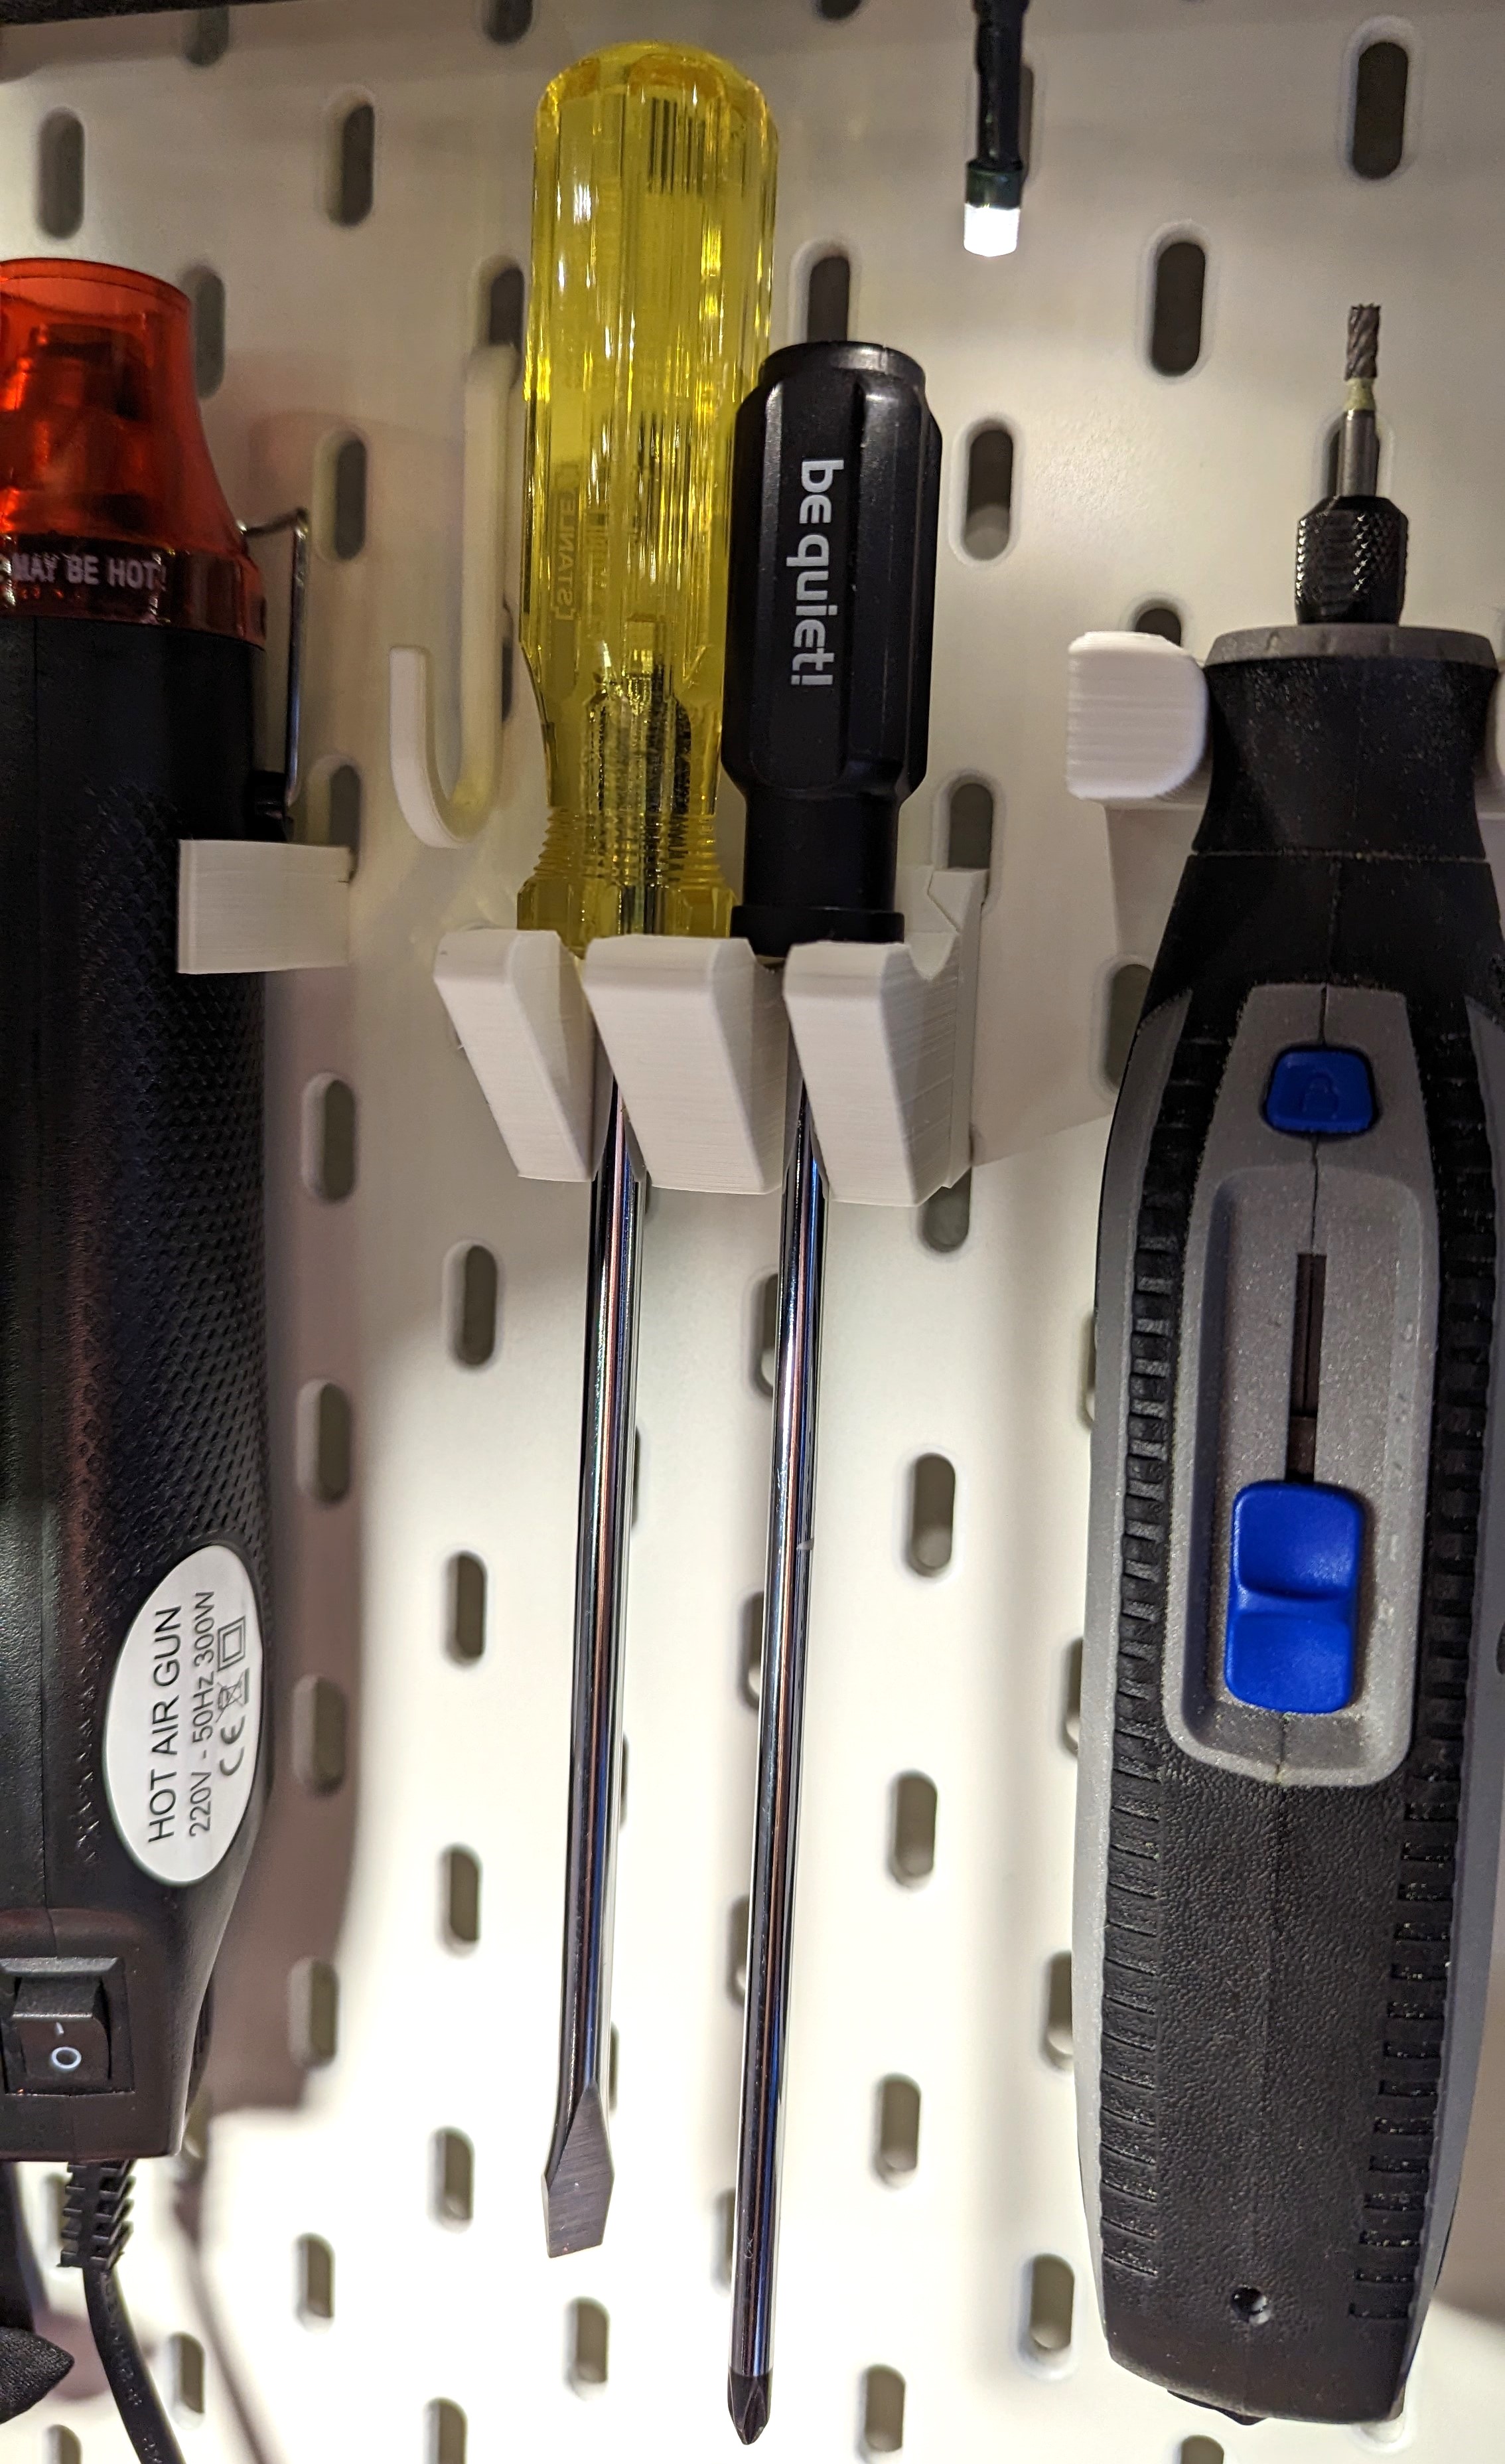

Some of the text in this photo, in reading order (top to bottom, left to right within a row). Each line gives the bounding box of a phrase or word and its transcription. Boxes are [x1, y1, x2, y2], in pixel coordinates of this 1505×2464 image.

[12, 552, 58, 582] MAY
[67, 554, 99, 585] BE
[786, 458, 844, 686] be quiet!
[194, 1591, 214, 1667] 300W
[148, 1605, 182, 1843] HOT AIR GUN
[192, 1670, 214, 1742] 50Hz
[220, 1715, 246, 1776] CE
[190, 1771, 213, 1837] 220V
